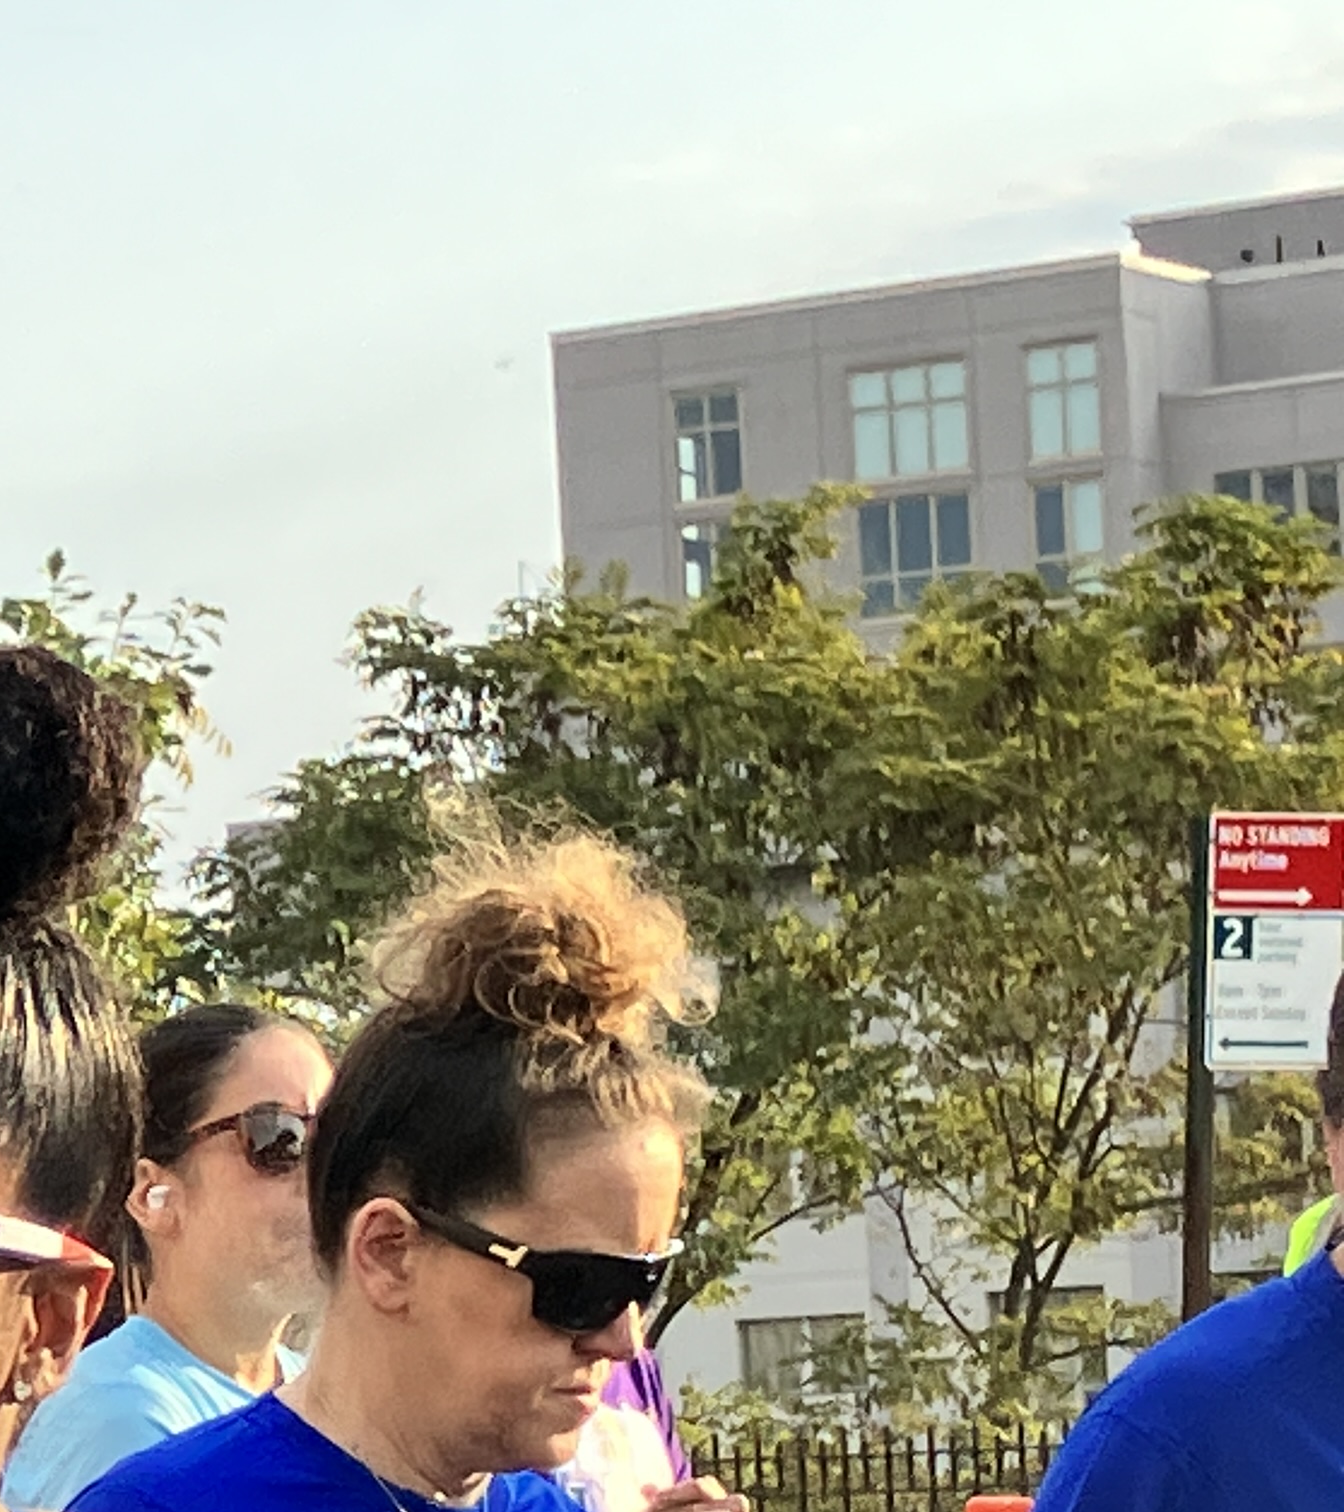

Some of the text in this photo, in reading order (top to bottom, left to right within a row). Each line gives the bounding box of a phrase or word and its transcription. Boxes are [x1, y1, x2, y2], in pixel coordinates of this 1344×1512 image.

[1218, 825, 1330, 847] NO STANDING
[1220, 917, 1244, 958] 2
